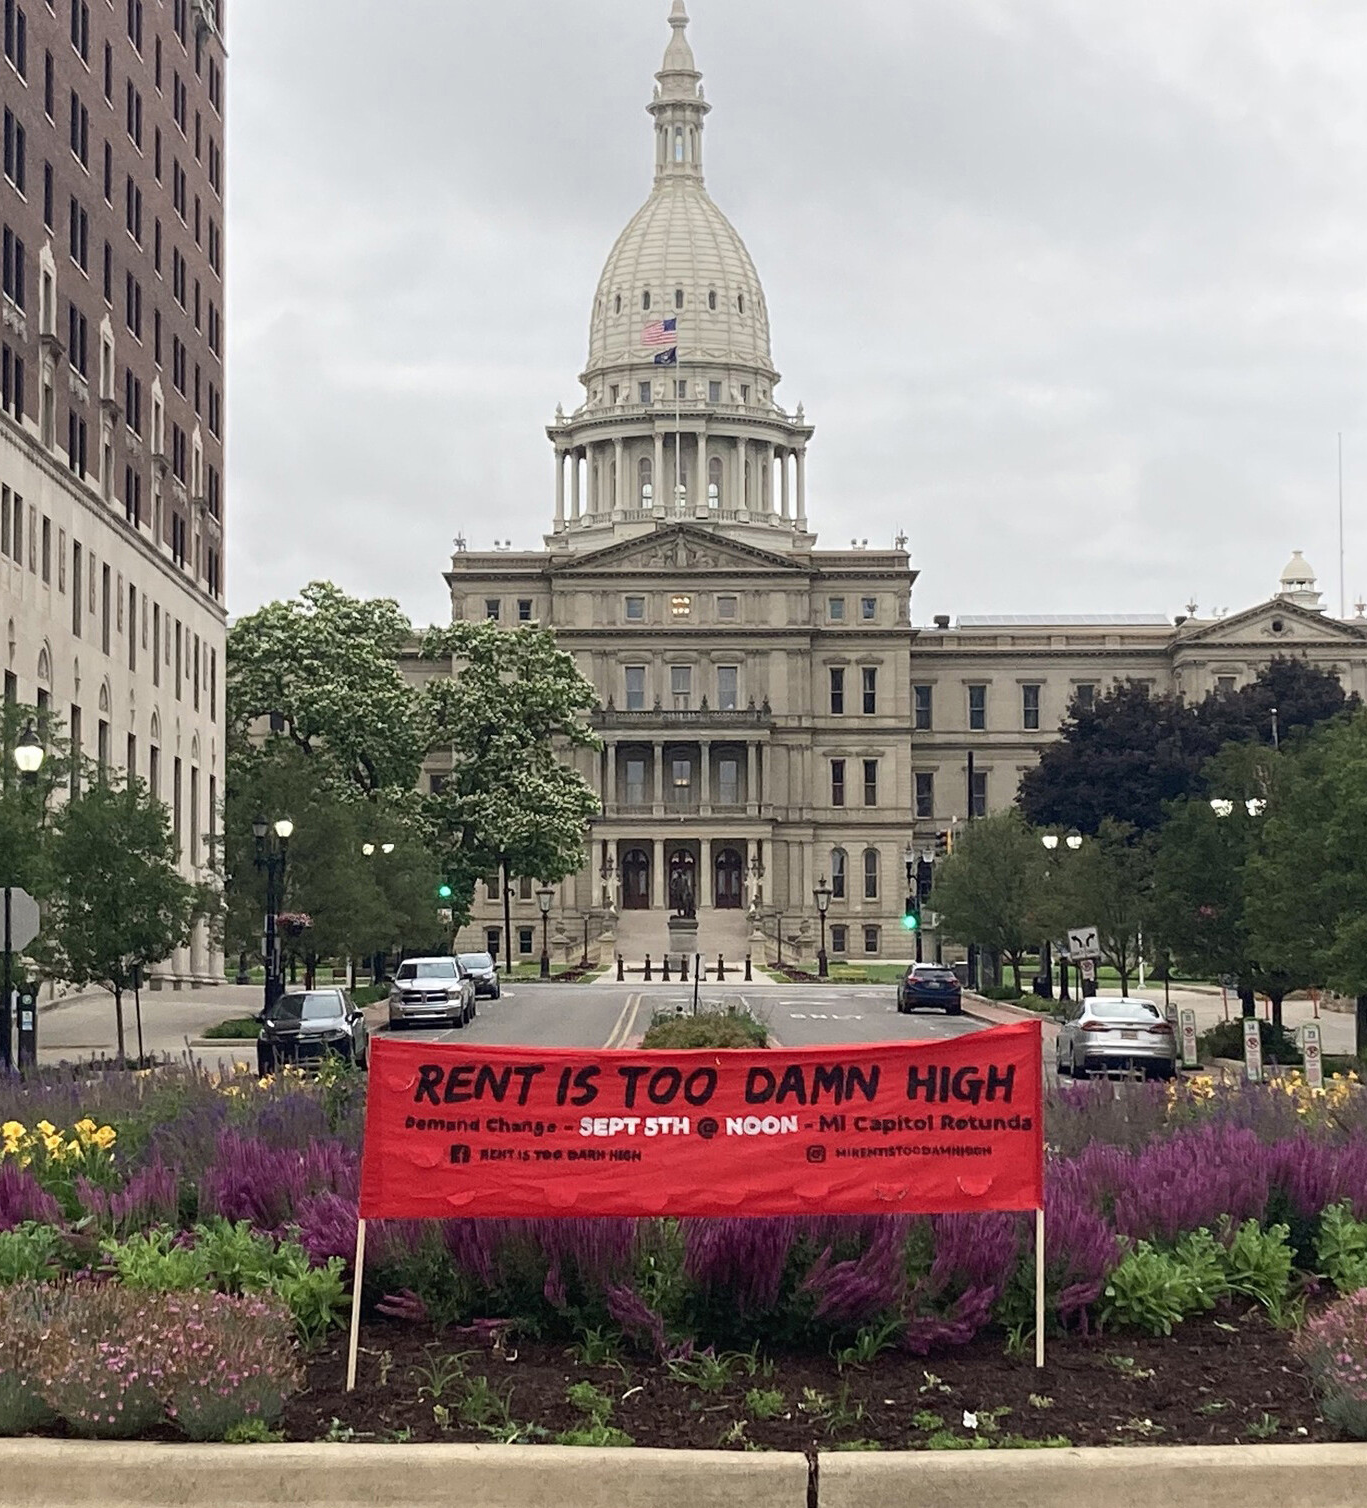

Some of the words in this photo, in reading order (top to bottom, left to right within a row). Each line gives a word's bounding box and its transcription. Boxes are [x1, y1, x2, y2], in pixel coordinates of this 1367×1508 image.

[414, 1064, 545, 1106] RENT
[556, 1065, 601, 1106] IS
[617, 1066, 718, 1109] TOO
[745, 1064, 880, 1106] DAMN
[907, 1064, 1016, 1105] HIGH
[405, 1116, 482, 1134] Demand
[486, 1117, 559, 1138] Change
[580, 1118, 642, 1138] SEPT
[645, 1117, 691, 1138] 5TH
[726, 1116, 799, 1137] NOON
[820, 1115, 847, 1134] MI
[854, 1115, 935, 1136] Capitol
[941, 1115, 1034, 1133] Rotunda
